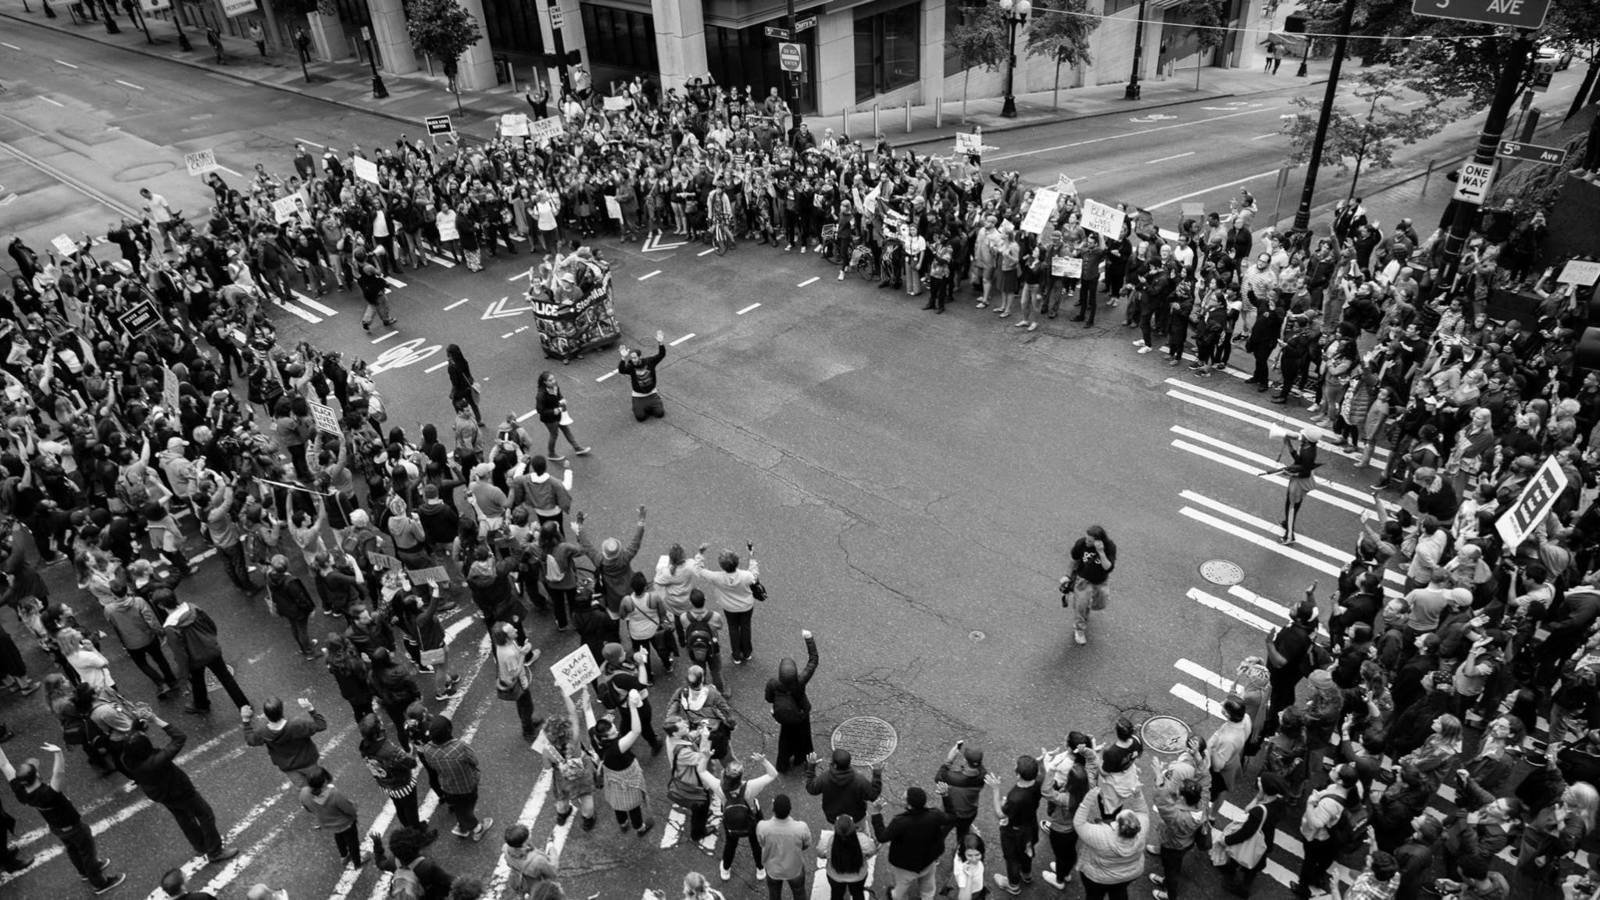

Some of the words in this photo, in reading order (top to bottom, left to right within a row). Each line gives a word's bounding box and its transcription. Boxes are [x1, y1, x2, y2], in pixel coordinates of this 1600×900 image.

[1486, 0, 1523, 15] AVE
[1503, 143, 1520, 155] 5th
[1540, 152, 1558, 161] Ave
[1465, 165, 1489, 178] ONE
[1462, 176, 1487, 188] WAY
